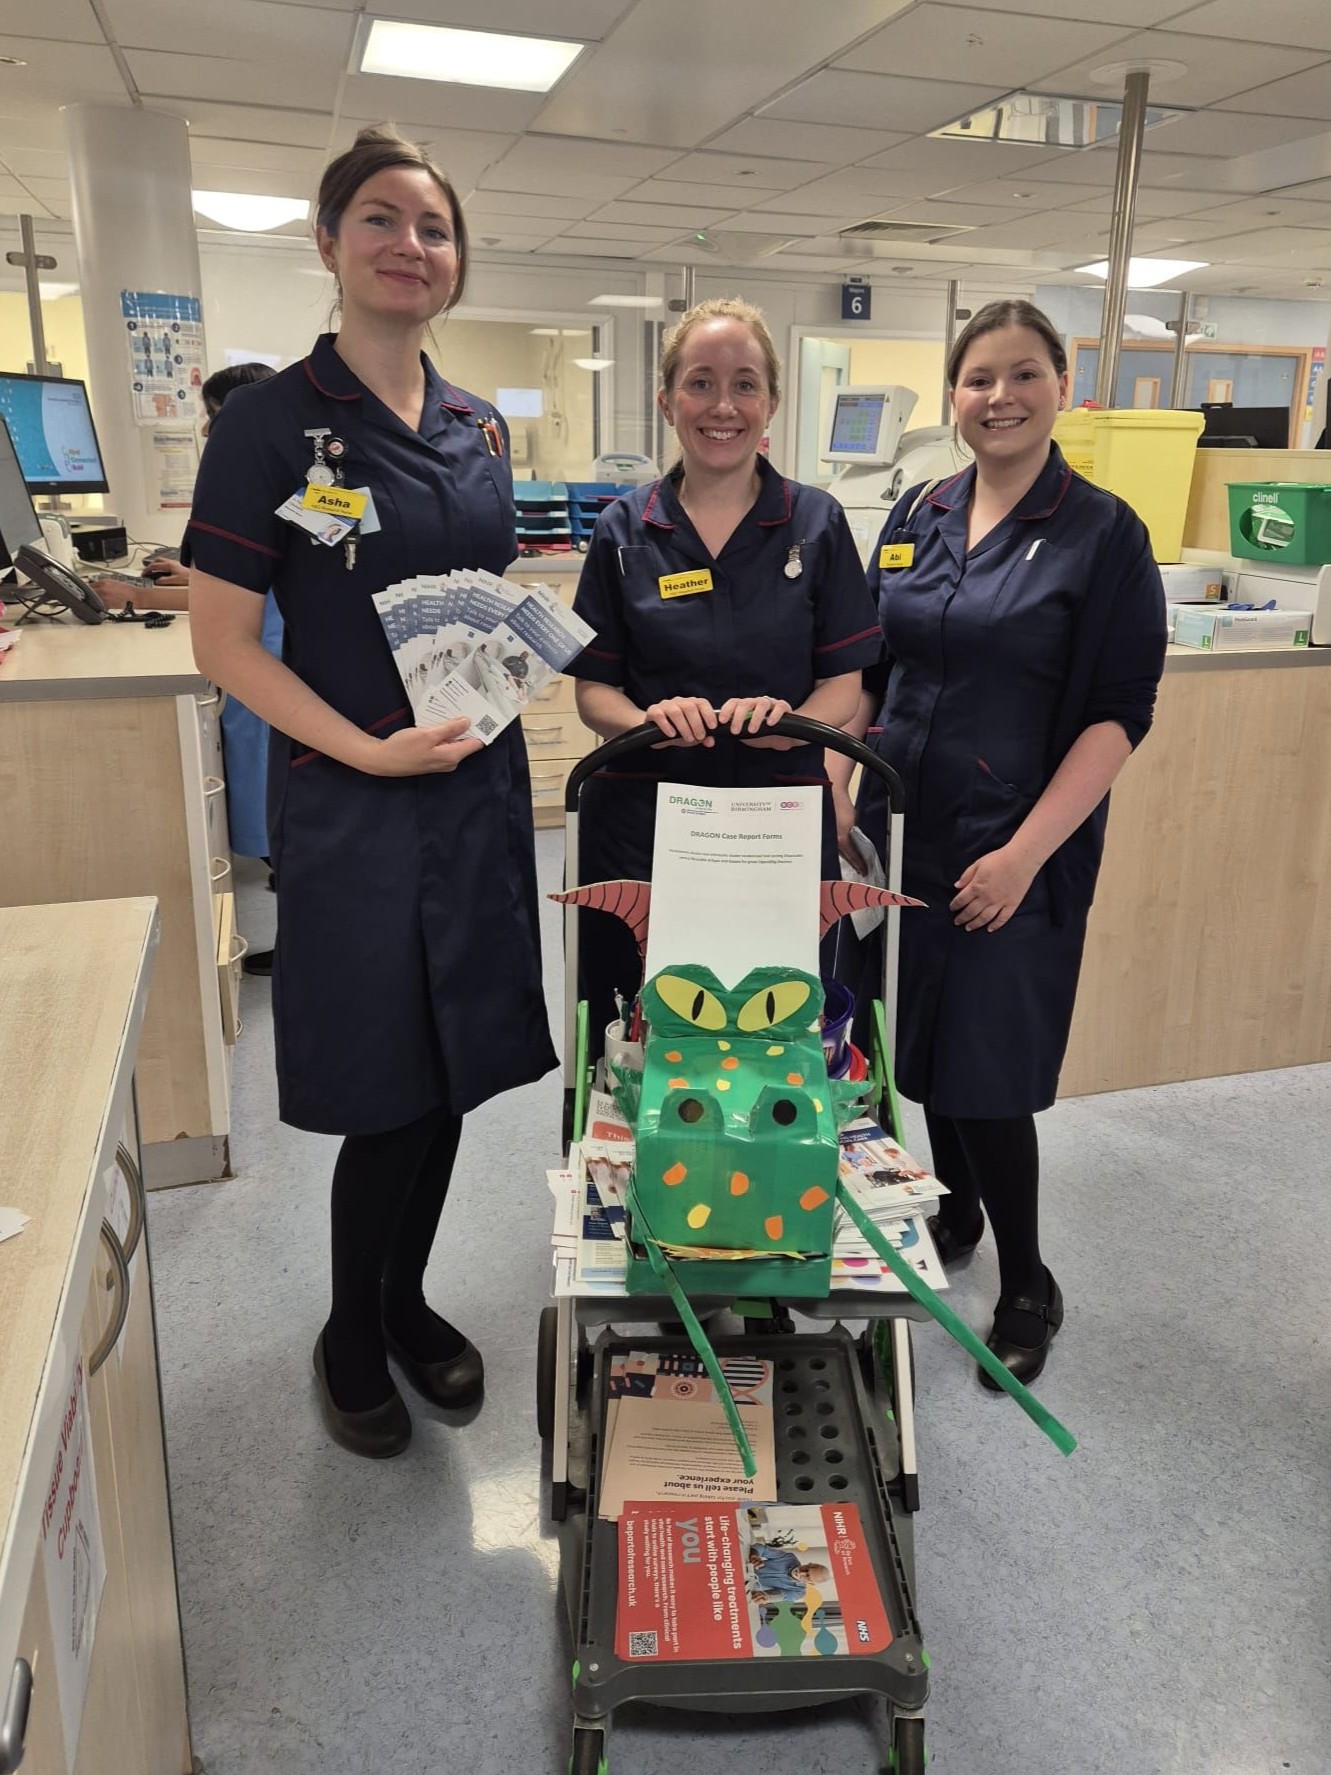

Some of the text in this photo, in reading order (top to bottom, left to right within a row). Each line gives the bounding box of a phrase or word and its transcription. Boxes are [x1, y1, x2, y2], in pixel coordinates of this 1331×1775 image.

[852, 297, 862, 314] 6
[318, 495, 350, 509] Asha
[1253, 492, 1279, 504] clinell
[890, 553, 901, 561] Abi
[664, 578, 709, 591] Heather
[1210, 585, 1216, 595] S
[690, 831, 720, 839] DRAGON
[664, 1482, 691, 1490] about
[676, 1475, 731, 1484] experience.
[723, 1486, 753, 1494] Please
[834, 1512, 846, 1535] NIHR
[675, 1517, 702, 1564] you
[625, 1520, 637, 1606] bepartofresearch.uk
[704, 1516, 724, 1621] start with people like
[719, 1516, 742, 1649] Life-changing treatments
[857, 1620, 869, 1641] NHS
[671, 1633, 679, 1645] part
